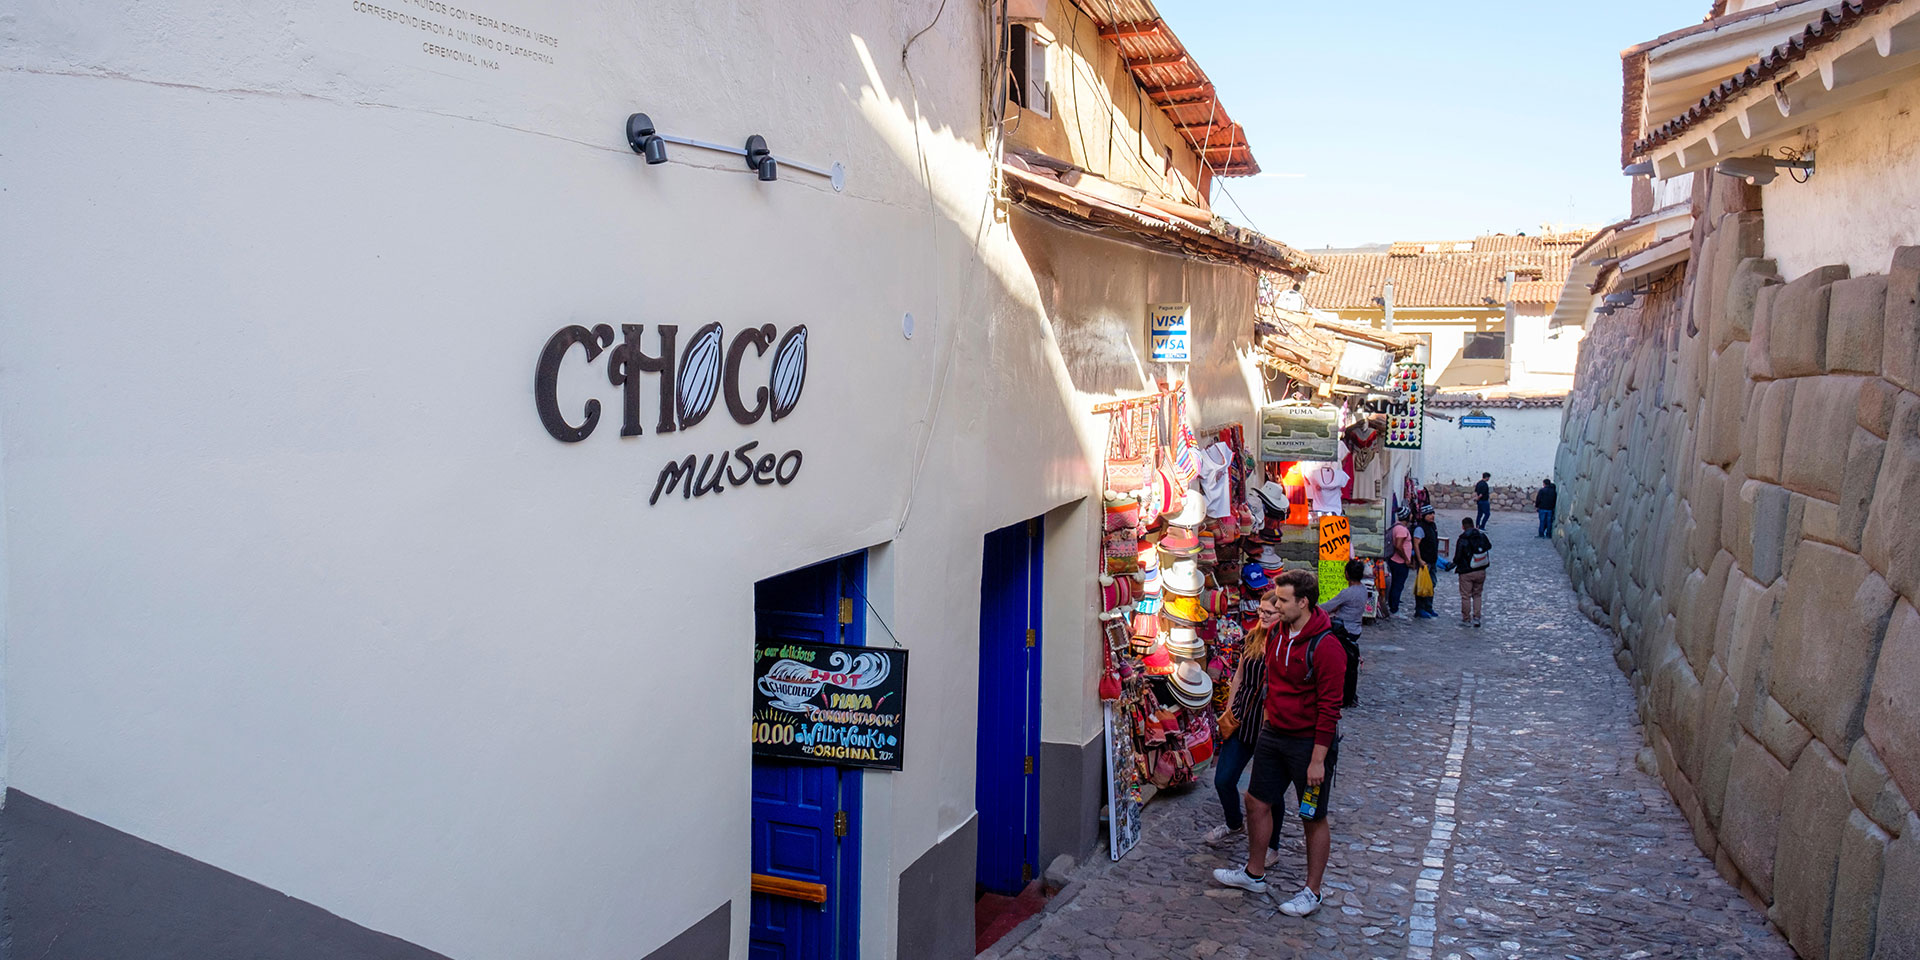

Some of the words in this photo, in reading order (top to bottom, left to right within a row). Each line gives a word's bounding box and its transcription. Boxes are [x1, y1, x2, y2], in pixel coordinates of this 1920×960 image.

[352, 0, 445, 35] CORRESPONDIERON
[447, 27, 454, 37] A
[457, 30, 469, 42] UN
[496, 41, 503, 52] O
[505, 44, 555, 65] PLATAFORMA
[449, 7, 468, 20] CON
[470, 13, 499, 30] PIEDRA
[502, 22, 531, 39] DIORITA
[533, 31, 558, 48] VERDE
[422, 42, 477, 66] CEREMONIAL
[480, 58, 500, 70] INKA
[1155, 316, 1185, 327] VISA
[1155, 339, 1185, 350] VISA
[535, 321, 808, 443] CHOCO
[1319, 534, 1350, 555] מתנה
[764, 647, 779, 658] our
[780, 644, 816, 663] delicious
[809, 668, 863, 688] HOT
[769, 681, 817, 698] CHOCOLATE
[814, 744, 879, 761] ORIGINAL
